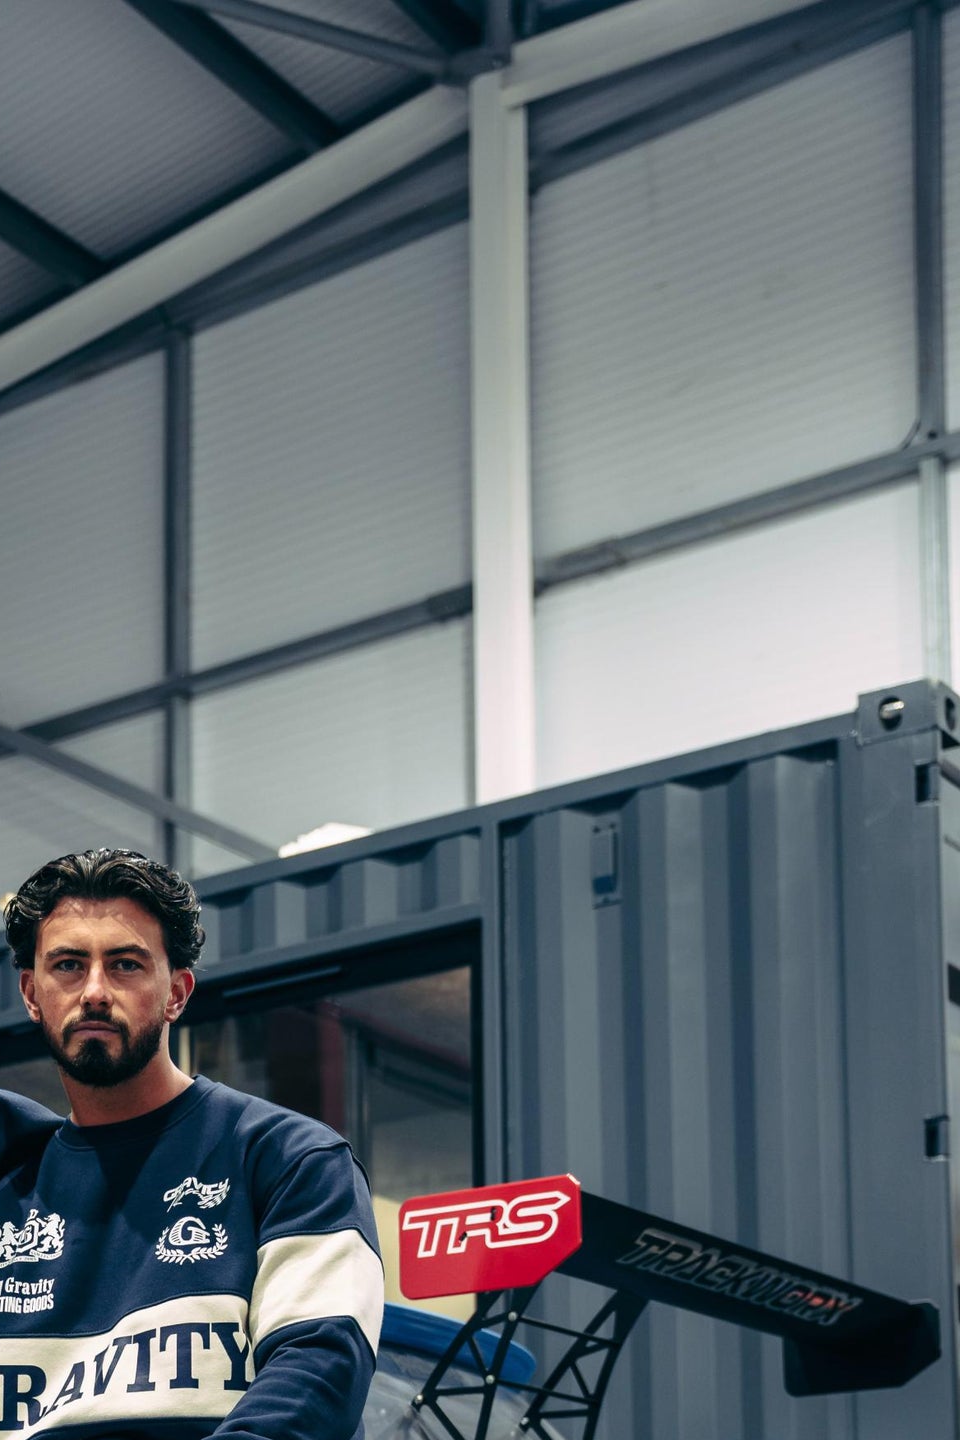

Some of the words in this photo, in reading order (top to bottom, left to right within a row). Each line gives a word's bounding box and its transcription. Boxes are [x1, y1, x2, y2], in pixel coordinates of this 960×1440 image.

[168, 1216, 211, 1246] G
[402, 1190, 572, 1259] TRS
[4, 1276, 56, 1296] Gravity
[23, 1293, 55, 1314] GOODS
